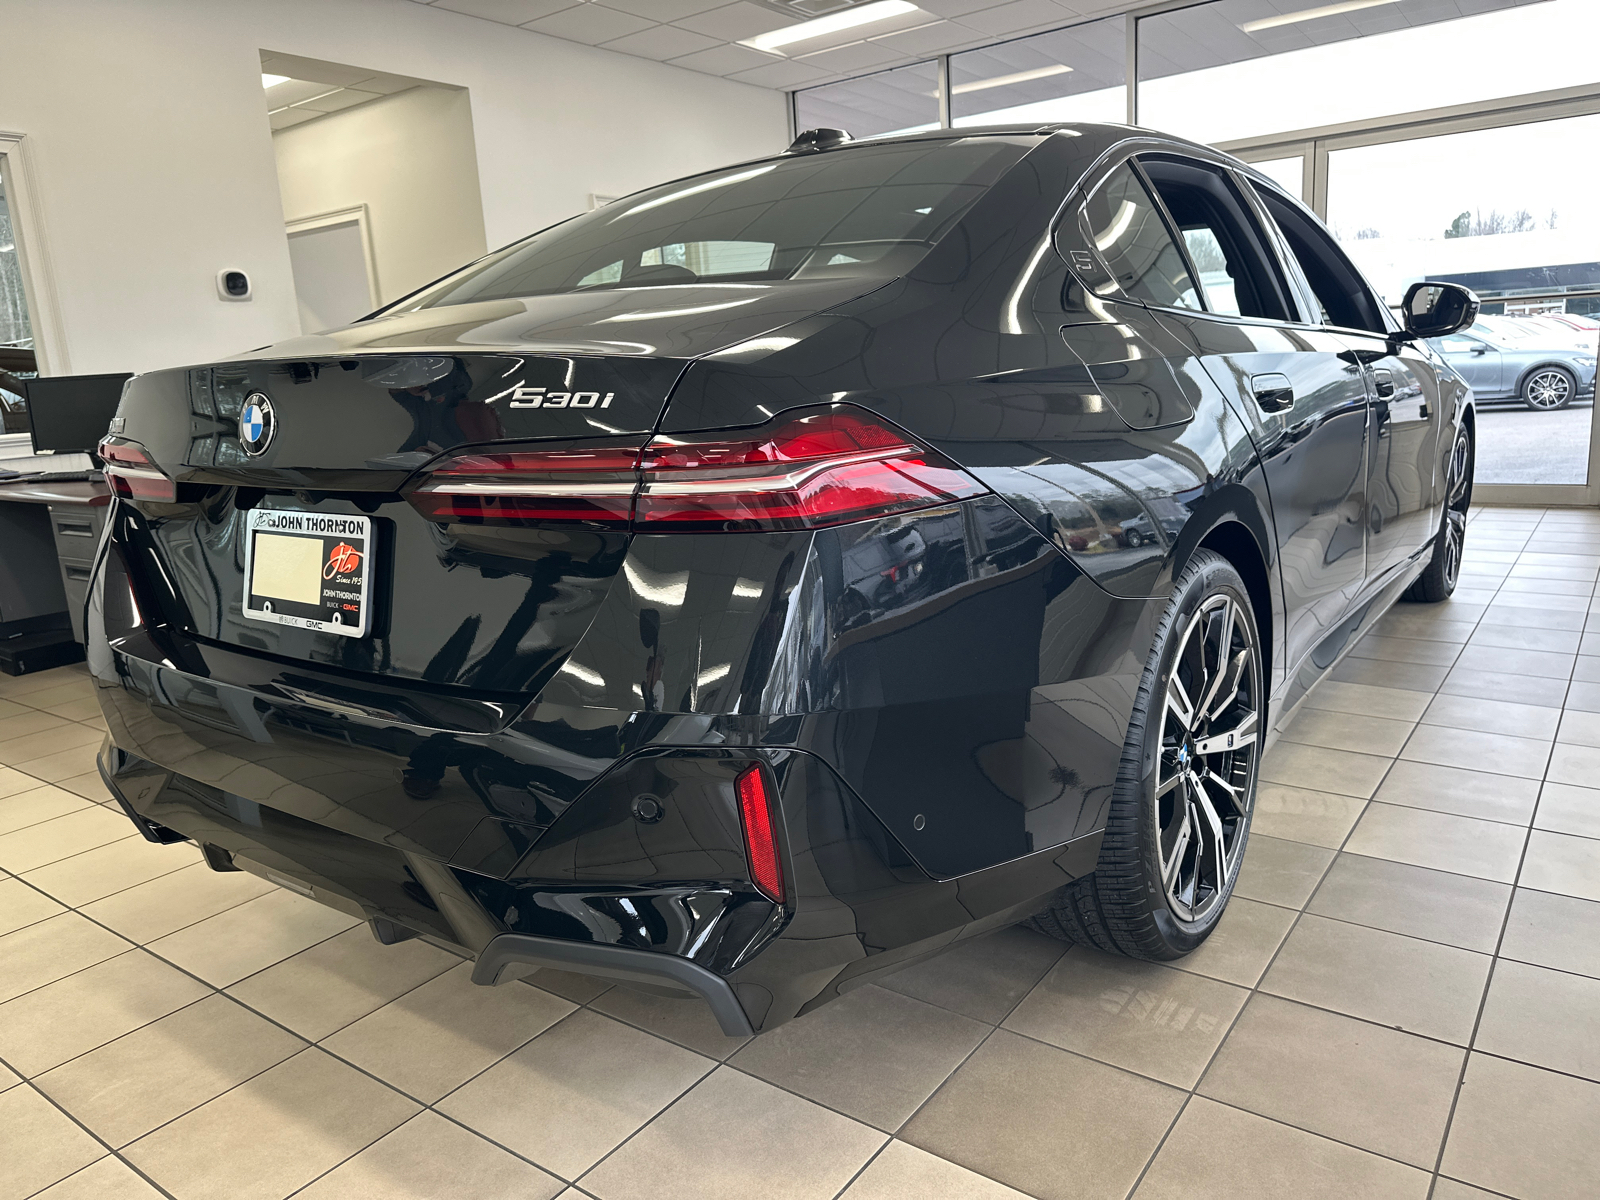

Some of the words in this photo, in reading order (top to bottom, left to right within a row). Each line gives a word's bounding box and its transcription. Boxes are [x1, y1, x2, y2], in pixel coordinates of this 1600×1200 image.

[509, 387, 615, 409] 530i
[276, 515, 303, 530] JOHN
[305, 517, 364, 535] THORNTON
[335, 574, 351, 584] Since
[351, 576, 362, 586] 195
[322, 588, 336, 599] JOHN
[335, 590, 361, 602] THORNTO
[326, 601, 339, 609] BUICK
[342, 603, 359, 612] GMC
[284, 615, 299, 626] BUICK
[306, 619, 323, 630] GMC
